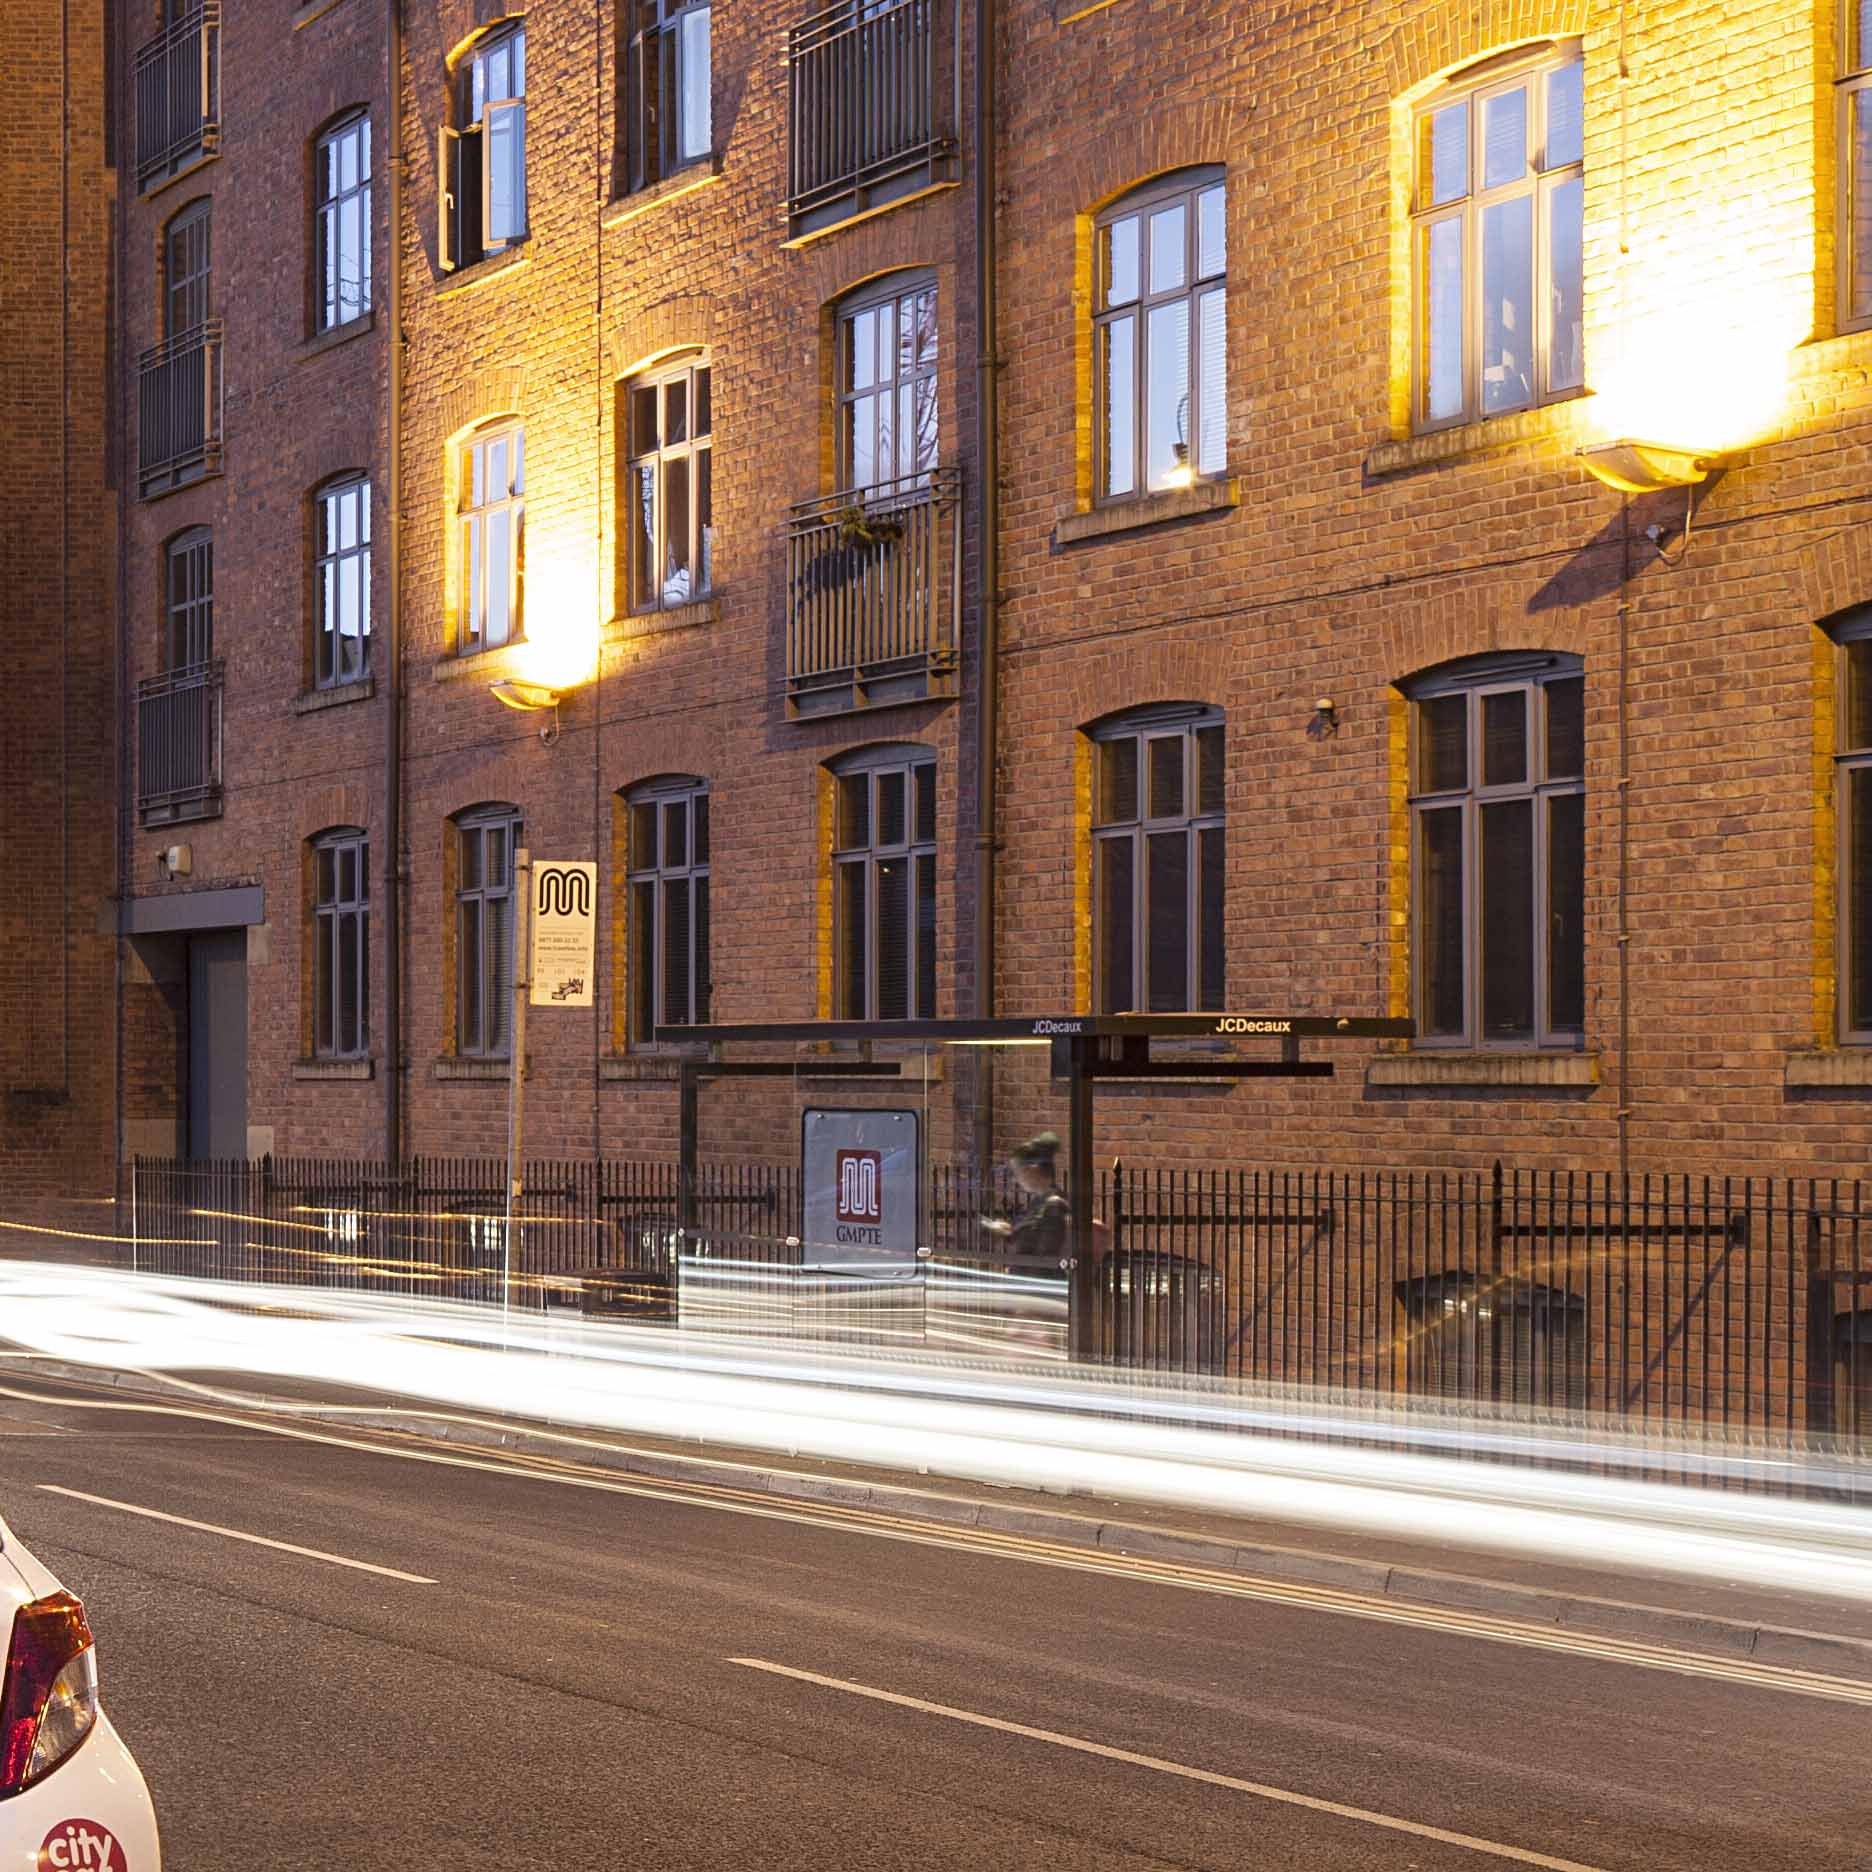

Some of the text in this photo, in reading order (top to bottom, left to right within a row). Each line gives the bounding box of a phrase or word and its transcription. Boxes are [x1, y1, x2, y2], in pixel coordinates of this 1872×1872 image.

[1032, 1020, 1082, 1034] JCDecaux
[1215, 1018, 1291, 1033] JCDecaux
[836, 1225, 882, 1245] GMPTE
[48, 1826, 113, 1872] city
